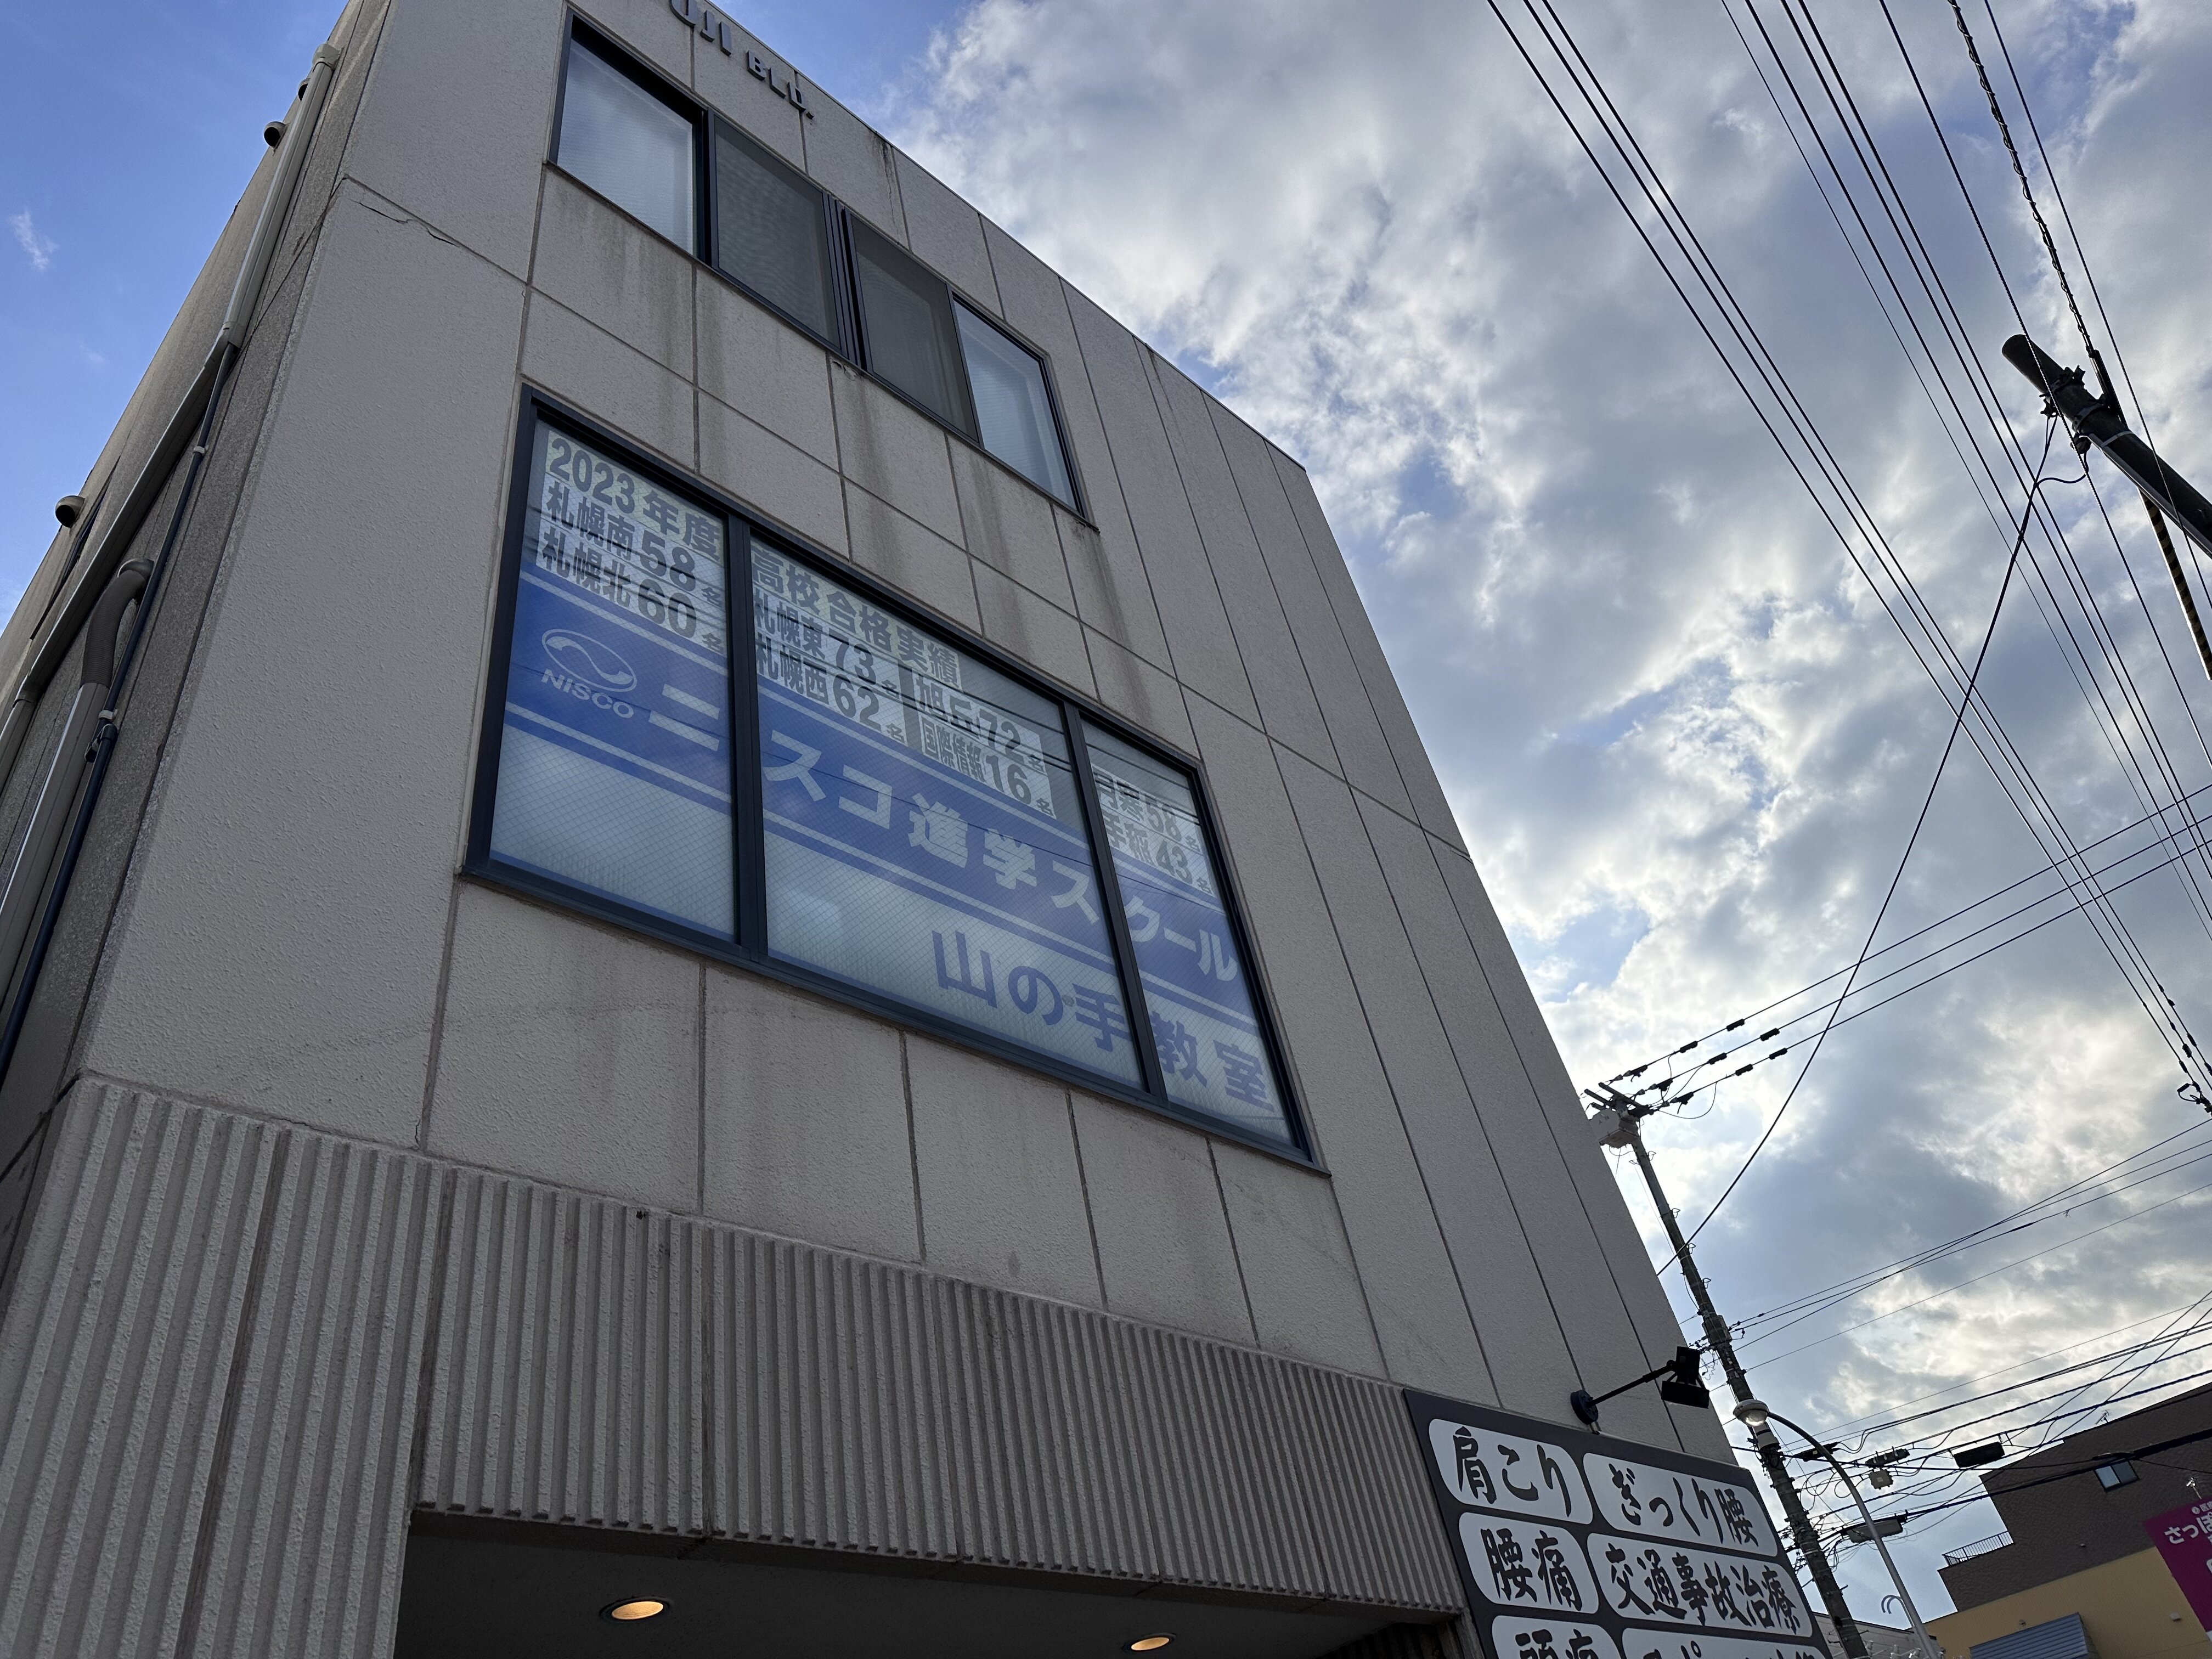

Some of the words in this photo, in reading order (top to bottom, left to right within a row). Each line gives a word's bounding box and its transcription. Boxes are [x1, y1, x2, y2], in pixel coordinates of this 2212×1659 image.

[541, 526, 723, 654] 札幌北60名
[545, 479, 721, 604] 札幌南58名
[549, 438, 721, 561] 2023年度
[749, 548, 959, 689] 高校合格実績
[541, 668, 634, 718] NISCO
[755, 632, 905, 742] 札幌西62名
[922, 715, 1054, 820] 国際情報16名
[932, 930, 1275, 1113] 山の手教室
[1453, 1426, 1572, 1517] 肩こり
[1609, 1463, 1759, 1546] ぎっくり腰
[1481, 1528, 1582, 1611] 腰痛
[1605, 1543, 1802, 1635] 交通事故治療
